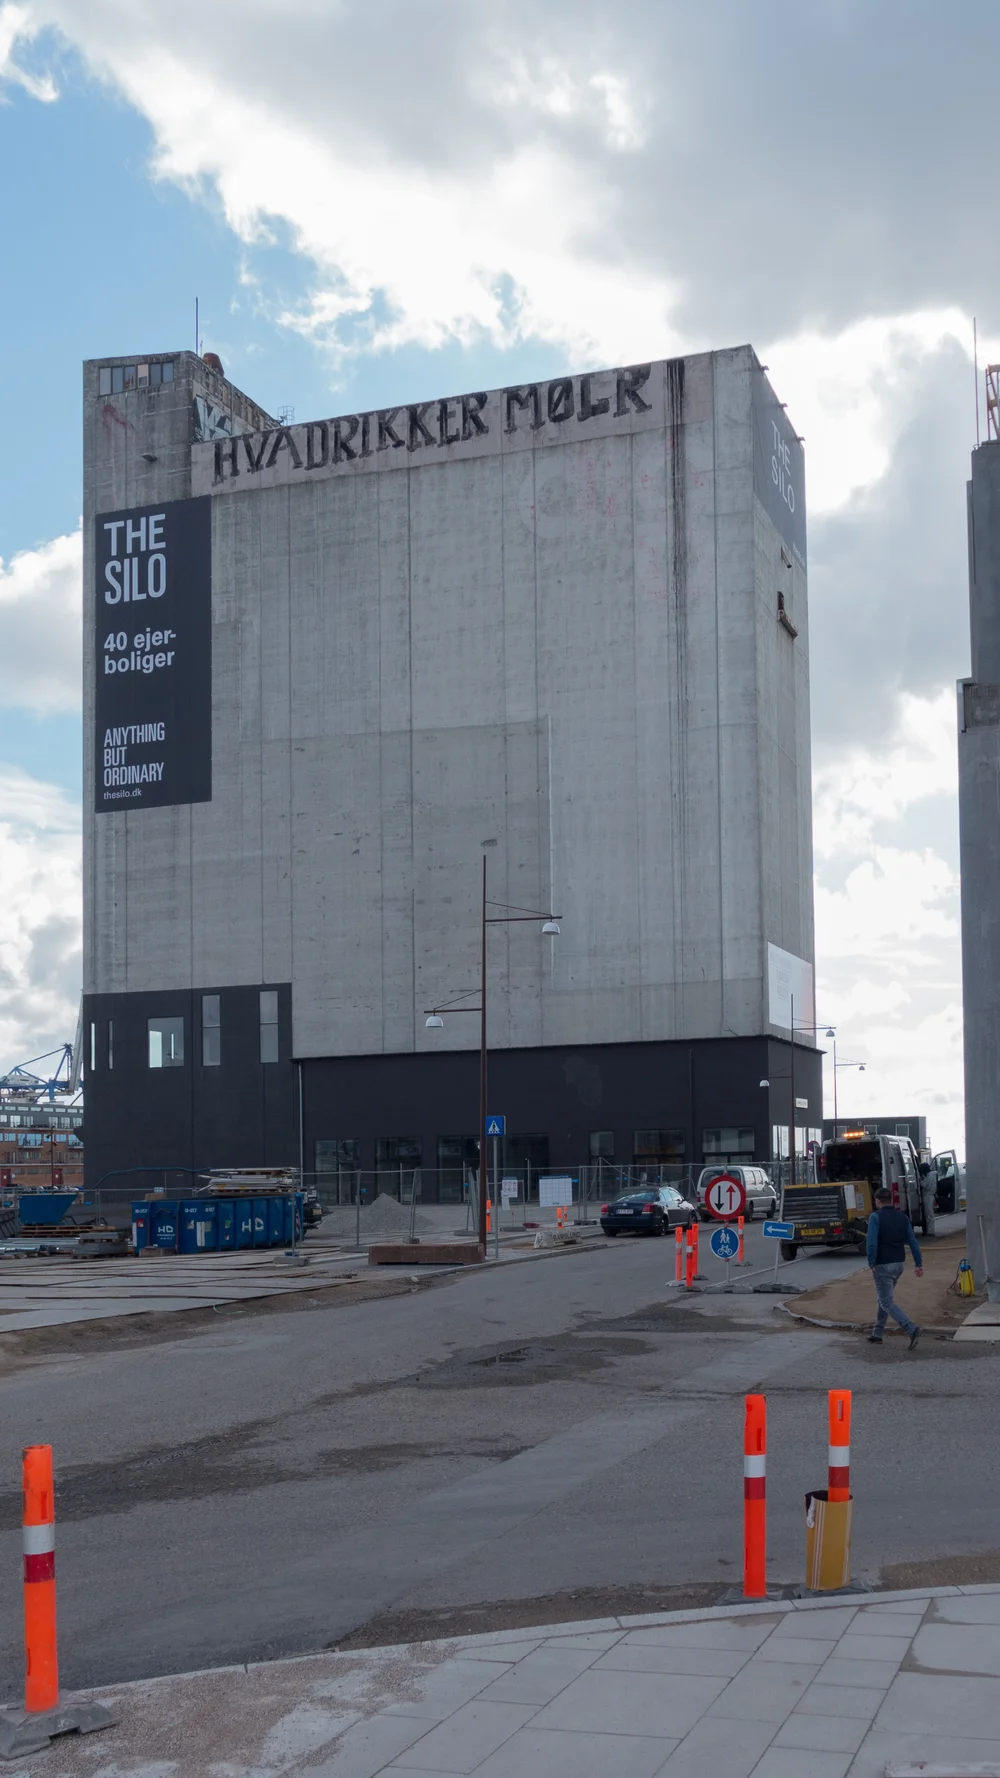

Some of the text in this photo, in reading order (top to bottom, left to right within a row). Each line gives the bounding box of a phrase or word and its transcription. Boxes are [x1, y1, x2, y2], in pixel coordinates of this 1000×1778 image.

[772, 421, 791, 476] THE
[771, 455, 795, 513] SILO
[103, 513, 167, 556] THE
[104, 553, 167, 605] SILO
[103, 627, 177, 652] 40 ejer-
[104, 651, 175, 674] boliger
[103, 722, 166, 748] ANYTHING
[103, 746, 127, 768] BUT
[103, 762, 165, 787] ORDINARY
[103, 788, 143, 800] thesilo.dk
[157, 1225, 174, 1233] HD
[241, 1217, 265, 1234] HD
